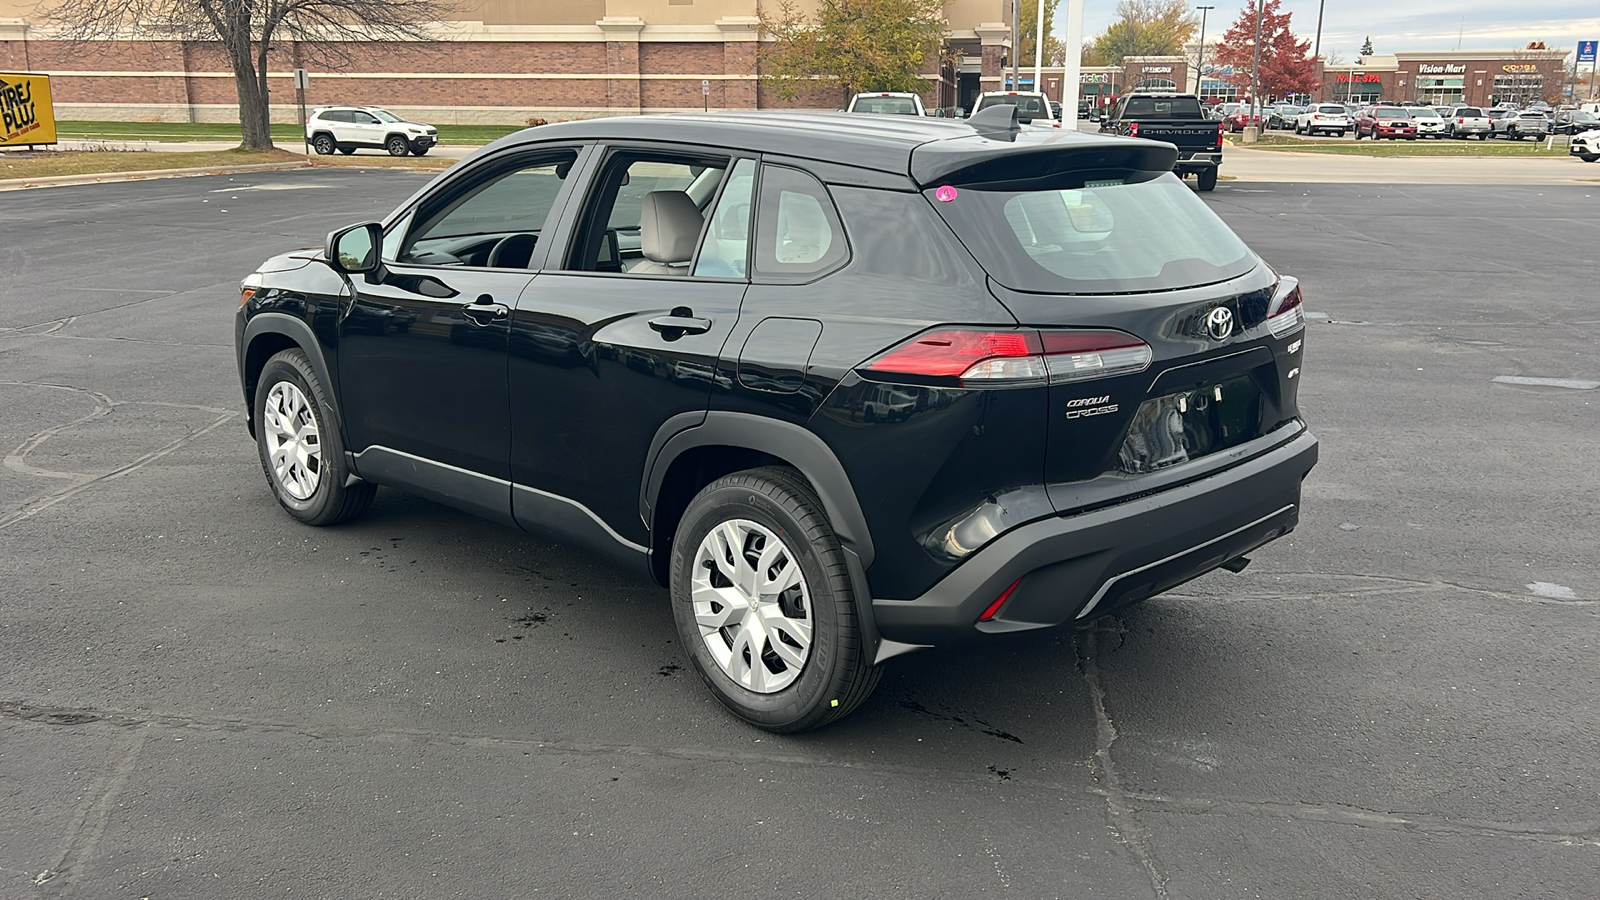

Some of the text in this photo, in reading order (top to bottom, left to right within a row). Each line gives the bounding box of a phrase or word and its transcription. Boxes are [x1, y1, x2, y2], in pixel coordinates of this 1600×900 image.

[1419, 64, 1466, 73] Vision Mart
[1079, 74, 1108, 83] ricket
[1362, 75, 1380, 83] SPA
[3, 102, 35, 134] PLUS
[1067, 395, 1110, 407] COROLLA
[1066, 404, 1119, 419] CROSS
